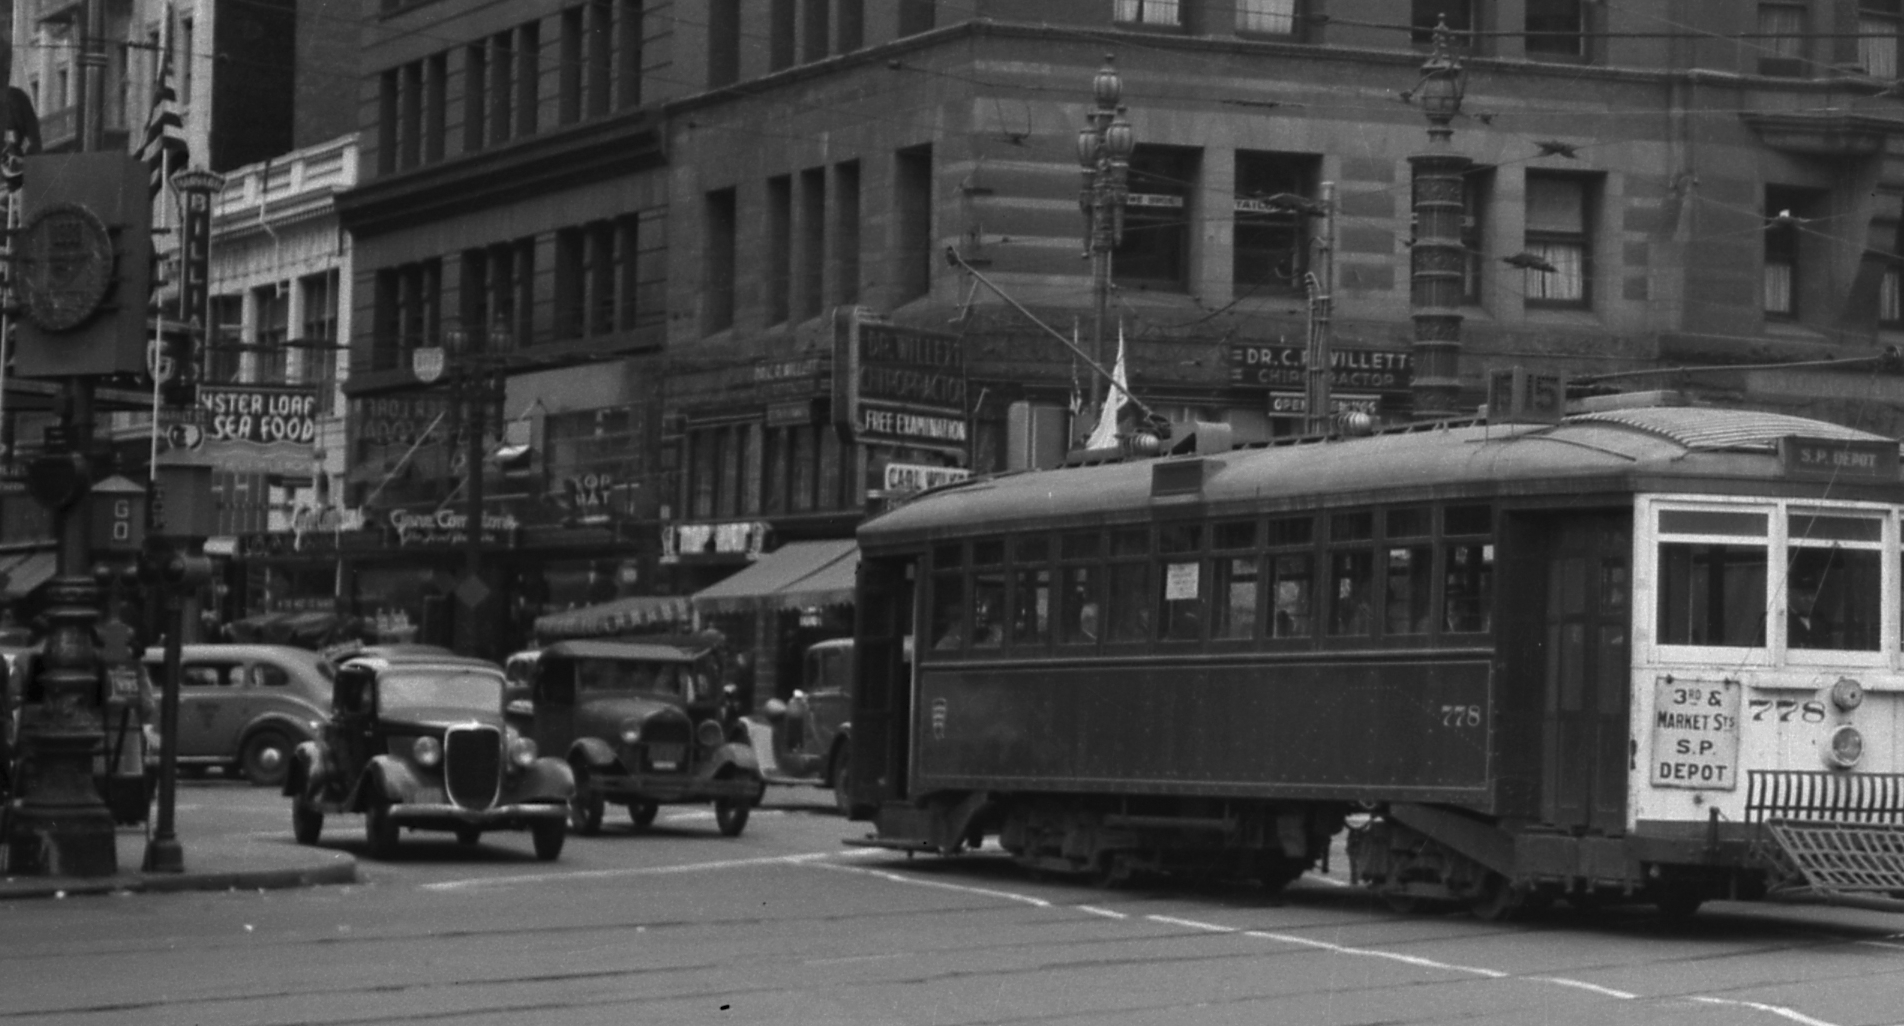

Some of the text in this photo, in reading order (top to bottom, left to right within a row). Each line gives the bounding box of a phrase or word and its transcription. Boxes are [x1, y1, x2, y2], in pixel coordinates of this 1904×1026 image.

[1525, 373, 1559, 412] 15
[268, 394, 316, 417] LOAF
[212, 415, 315, 442] SEA FOOD
[865, 408, 967, 441] FREE EXAMINATION
[1833, 451, 1877, 468] DEPOT
[570, 473, 612, 490] TOP
[575, 489, 611, 506] HAT
[113, 499, 130, 541] GO
[1707, 690, 1722, 707] &
[1440, 704, 1481, 727] 778
[1657, 711, 1711, 730] MARKET
[1748, 699, 1826, 724] 778
[1676, 739, 1717, 755] S.P.
[1659, 762, 1728, 781] DEPOT
